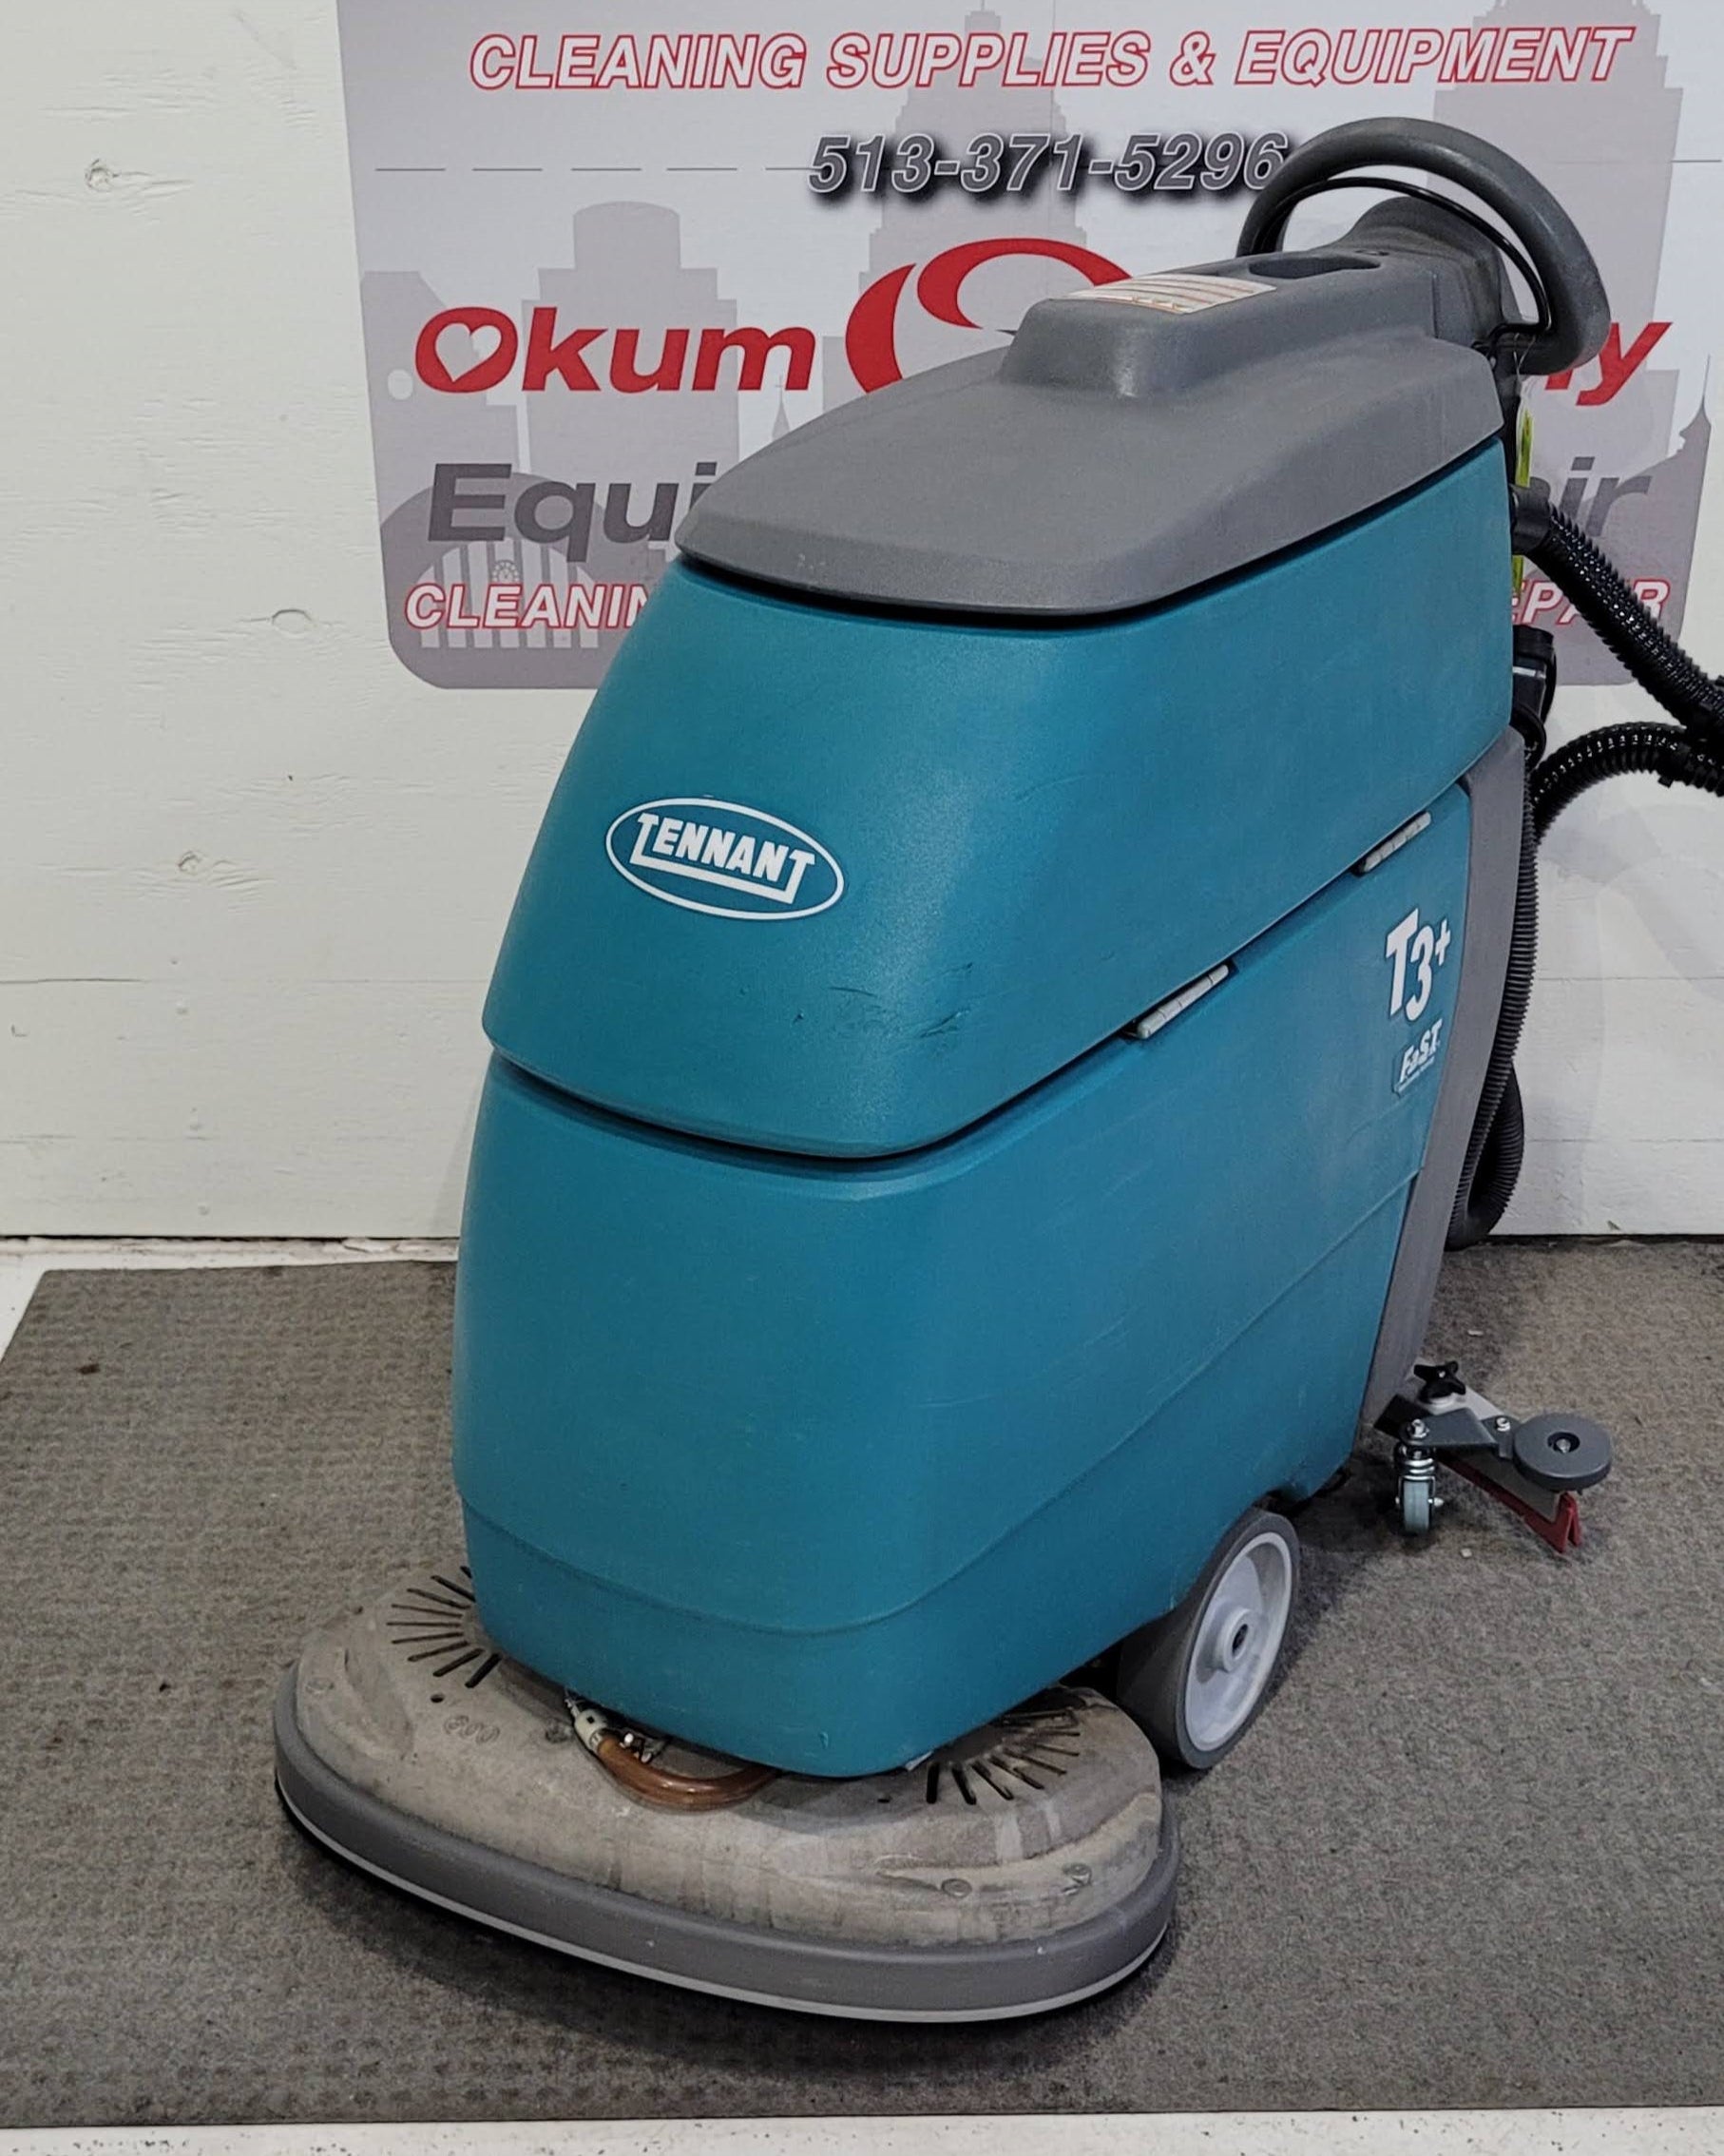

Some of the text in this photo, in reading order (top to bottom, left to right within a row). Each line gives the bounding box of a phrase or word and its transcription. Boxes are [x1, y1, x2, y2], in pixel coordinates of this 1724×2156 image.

[470, 27, 1636, 89] CLEANING SUPPLIES & EQUIPMENT
[808, 131, 1289, 192] 513-371-5296
[415, 306, 815, 394] Okum
[629, 813, 815, 904] TENNANT
[1386, 908, 1451, 1022] T3+
